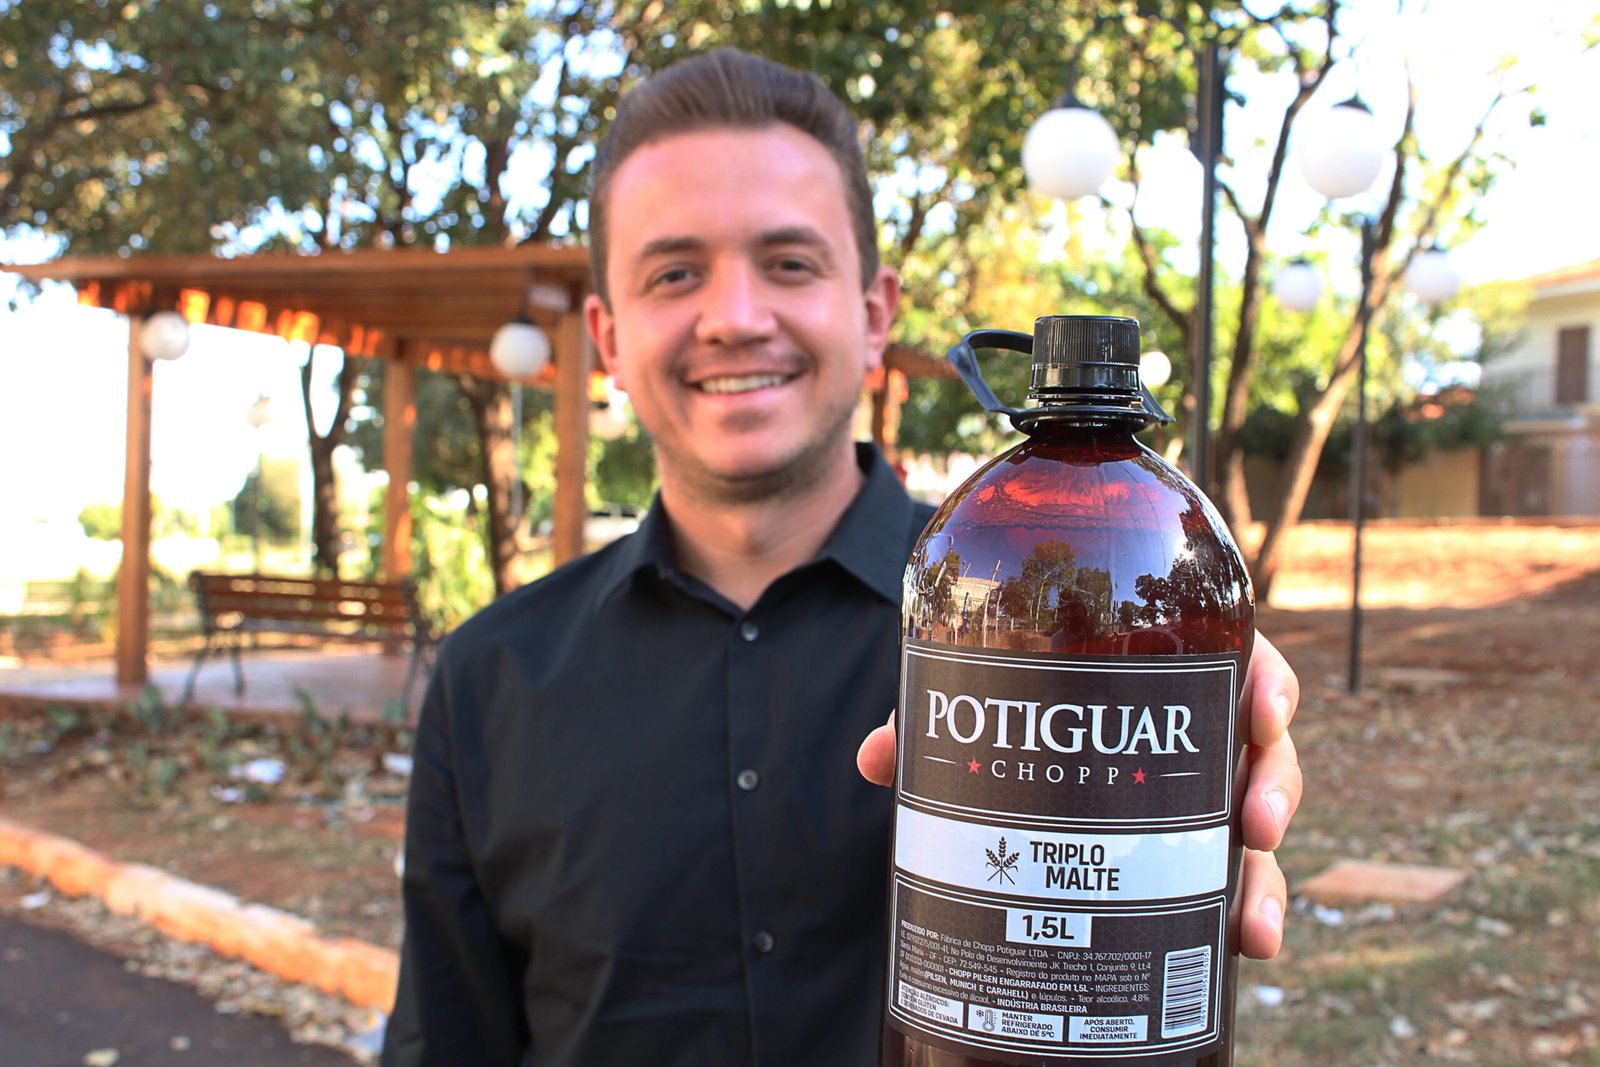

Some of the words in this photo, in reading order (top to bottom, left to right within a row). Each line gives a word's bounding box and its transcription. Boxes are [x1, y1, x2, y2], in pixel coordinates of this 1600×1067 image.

[926, 689, 1200, 755] POTIGUAR
[991, 760, 1119, 785] CHOPP
[1030, 841, 1105, 866] TRIPLO
[1046, 866, 1120, 891] MALTE
[1022, 914, 1074, 940] 1,5L
[963, 939, 971, 948] de
[973, 941, 995, 953] Chopp
[997, 945, 1026, 957] Potiguar
[1028, 949, 1048, 958] LTDA
[1057, 951, 1080, 960] CNPJ:
[961, 949, 975, 959] Polo
[976, 952, 985, 961] de
[987, 954, 1048, 969] Desenvolvimento
[1049, 962, 1060, 970] JK
[1062, 962, 1087, 971] Trecho
[1096, 963, 1129, 973] Conjunto
[949, 967, 972, 979] CHOPP
[972, 972, 998, 985] PILSEN
[999, 977, 1058, 991] ENGARRAFADO
[1059, 984, 1072, 992] EM
[1073, 984, 1089, 993] 1,5L
[1095, 983, 1150, 993] INGREDIENTES:
[1006, 967, 1036, 979] Registro
[1038, 971, 1048, 980] do
[1050, 972, 1080, 982] produto
[1082, 974, 1092, 982] no
[1094, 973, 1117, 981] MAPA
[1119, 973, 1132, 981] sob
[950, 977, 977, 991] MUNICH
[979, 984, 985, 993] E
[986, 986, 1029, 1000] CARAHELL)
[1078, 994, 1094, 1002] Teor
[960, 991, 968, 999] de
[997, 998, 1039, 1011] INDÚSTRIA
[1040, 1003, 1087, 1013] BRASILEIRA
[936, 1012, 959, 1025] CEVADA
[1002, 1012, 1033, 1022] MANTER
[1002, 1019, 1053, 1031] REFRIGERADO
[1084, 1018, 1104, 1026] APÓS
[1001, 1026, 1028, 1036] ABAIXO
[1030, 1029, 1039, 1037] DE
[1080, 1032, 1137, 1040] IMEDIATAMENTE
